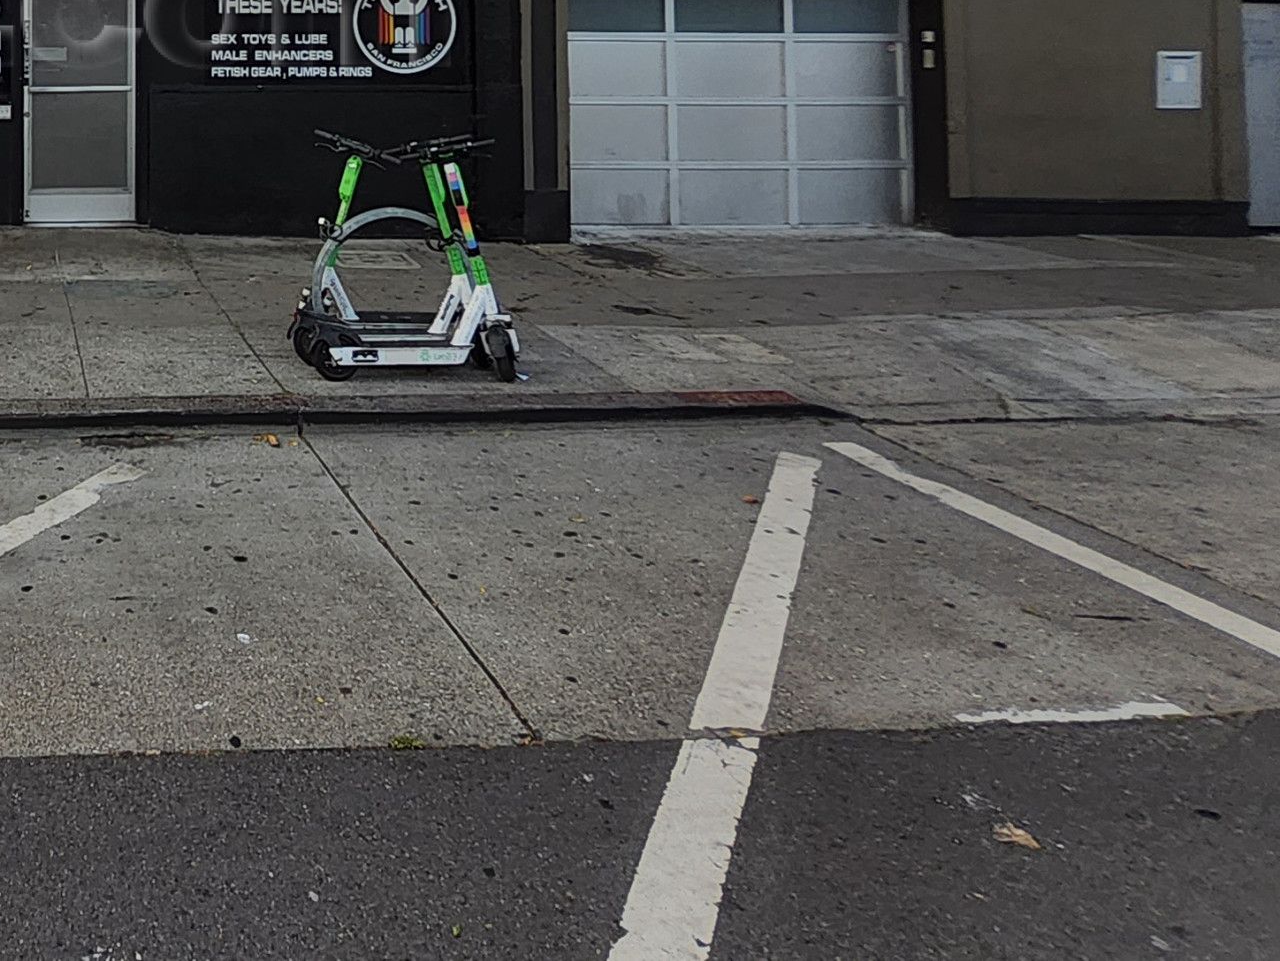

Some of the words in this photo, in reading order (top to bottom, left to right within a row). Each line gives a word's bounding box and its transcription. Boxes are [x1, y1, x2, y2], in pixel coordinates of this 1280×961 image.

[211, 33, 237, 45] SEX
[241, 33, 276, 45] TOYS
[280, 33, 291, 45] &
[295, 33, 328, 45] LUBE
[211, 50, 248, 61] MALE
[254, 50, 334, 61] ENHANCERS
[366, 42, 386, 62] SAN
[386, 42, 444, 69] FRANCISCO
[211, 66, 249, 77] FETISH
[288, 66, 327, 77] PUMPS
[329, 66, 338, 77] &
[338, 66, 373, 77] RINGS
